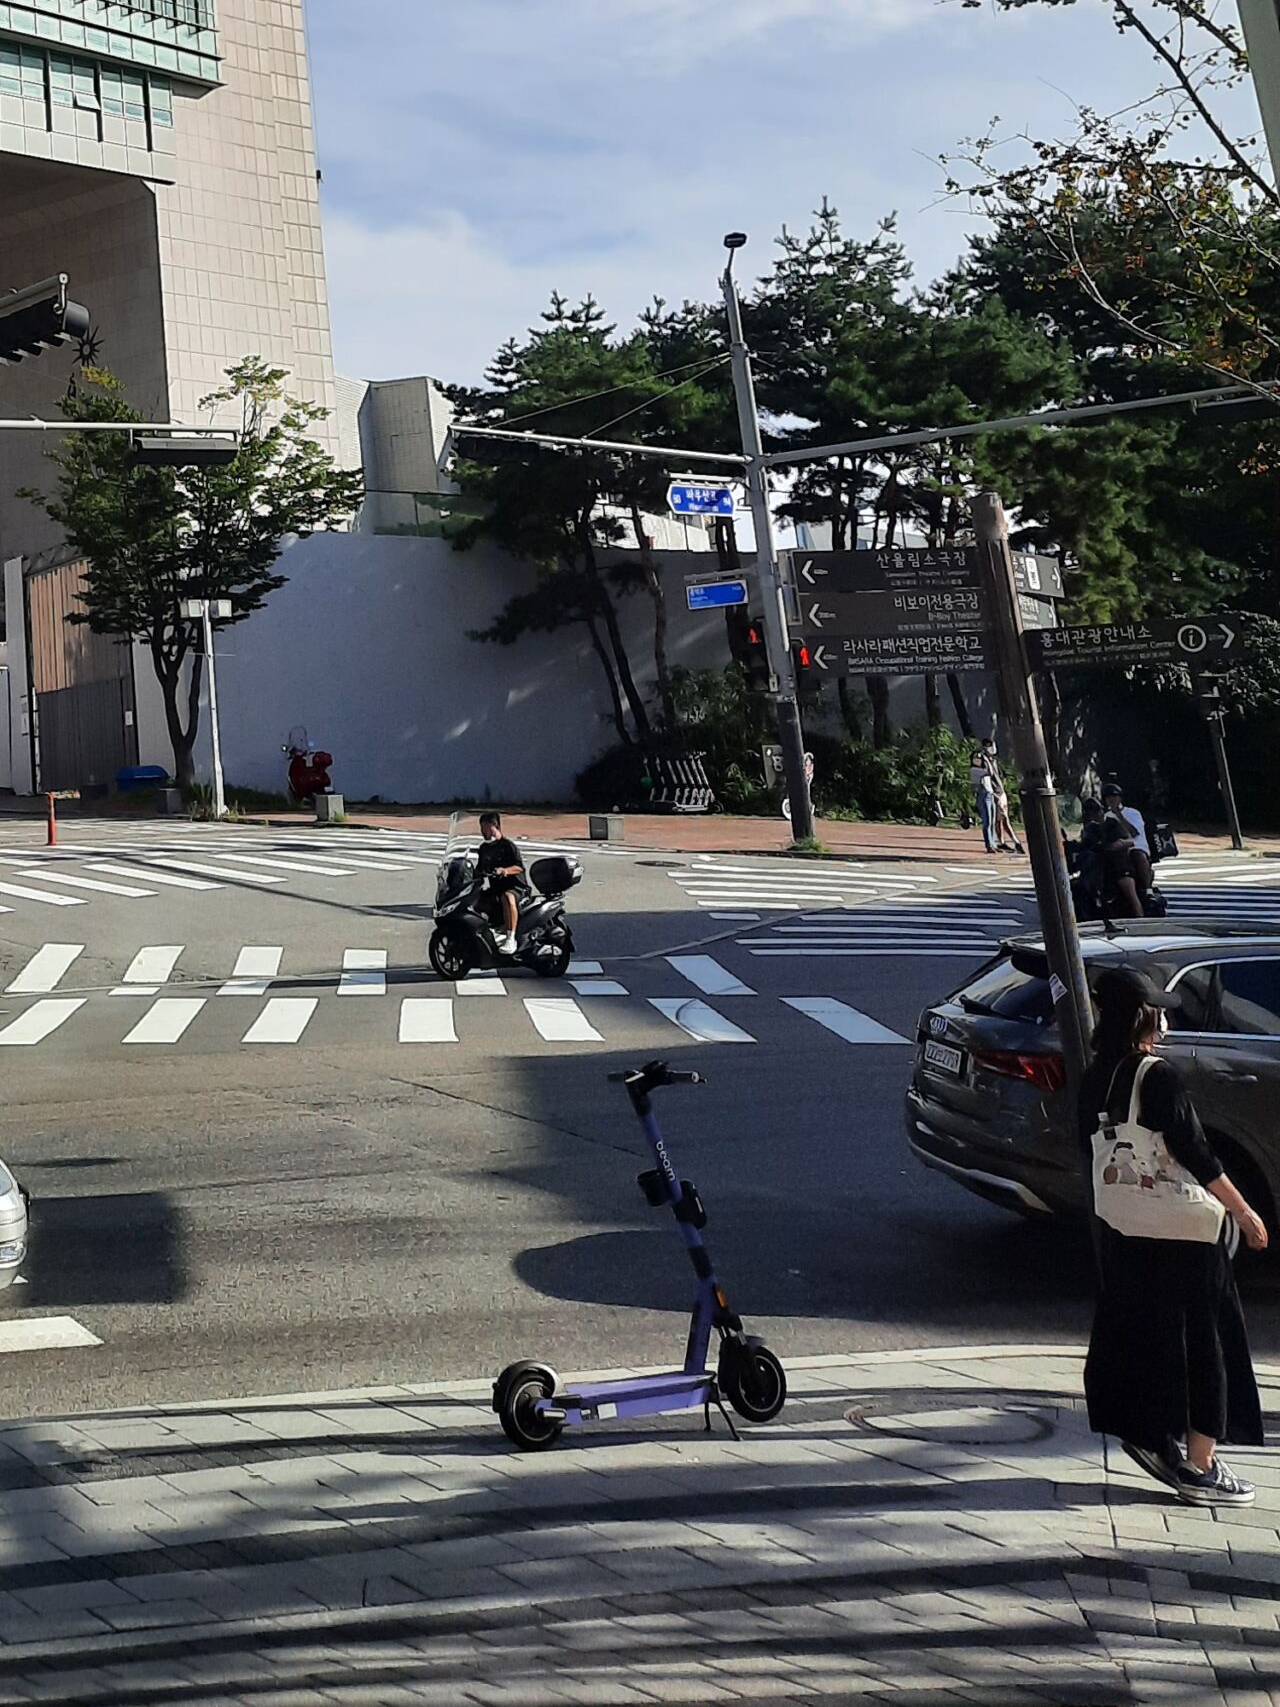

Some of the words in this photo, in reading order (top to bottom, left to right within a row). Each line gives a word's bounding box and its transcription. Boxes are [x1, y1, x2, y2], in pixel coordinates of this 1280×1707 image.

[876, 551, 967, 569] 산울림소극장
[894, 592, 979, 612] 비보이전용극장
[843, 635, 983, 655] 라사라패션직업전문학교
[1040, 624, 1153, 649] 홍대관광안내소
[656, 1140, 676, 1182] beam
